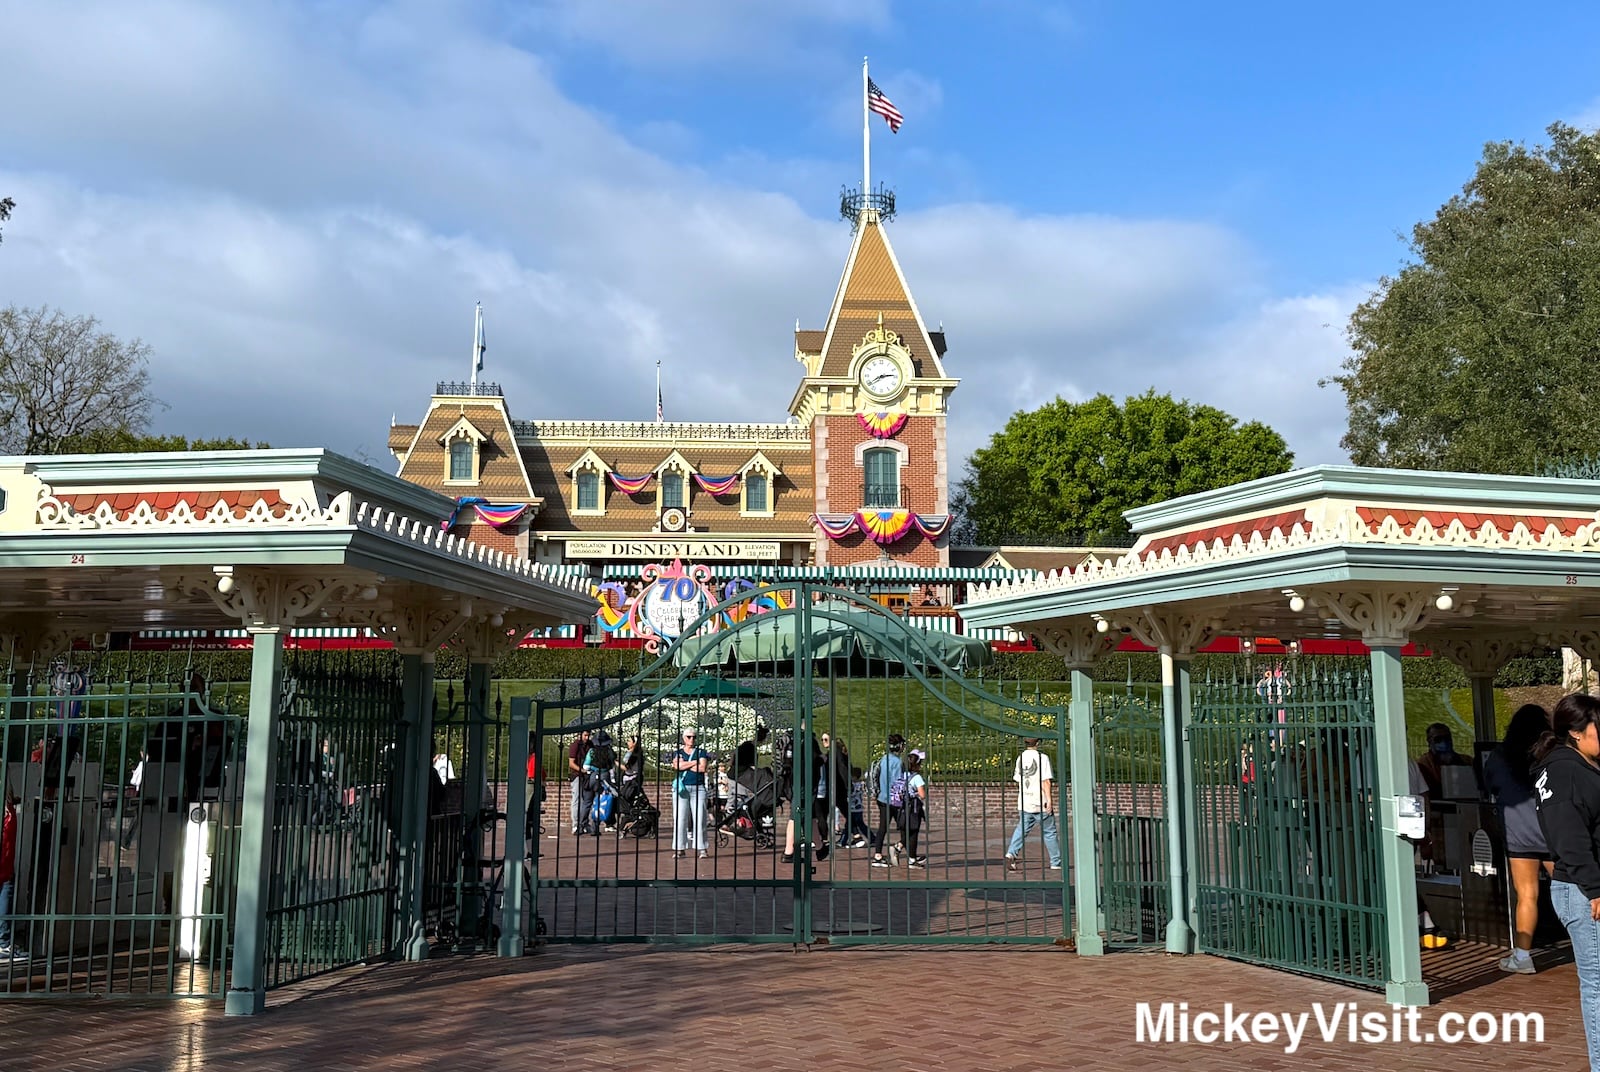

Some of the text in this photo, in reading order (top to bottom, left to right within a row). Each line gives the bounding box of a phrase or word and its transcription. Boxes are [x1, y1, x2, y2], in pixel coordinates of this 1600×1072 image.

[612, 543, 741, 556] DISNEYLAND
[71, 553, 85, 564] 24
[1566, 575, 1578, 585] 25
[657, 576, 696, 602] 70
[656, 607, 695, 617] CELEBATE
